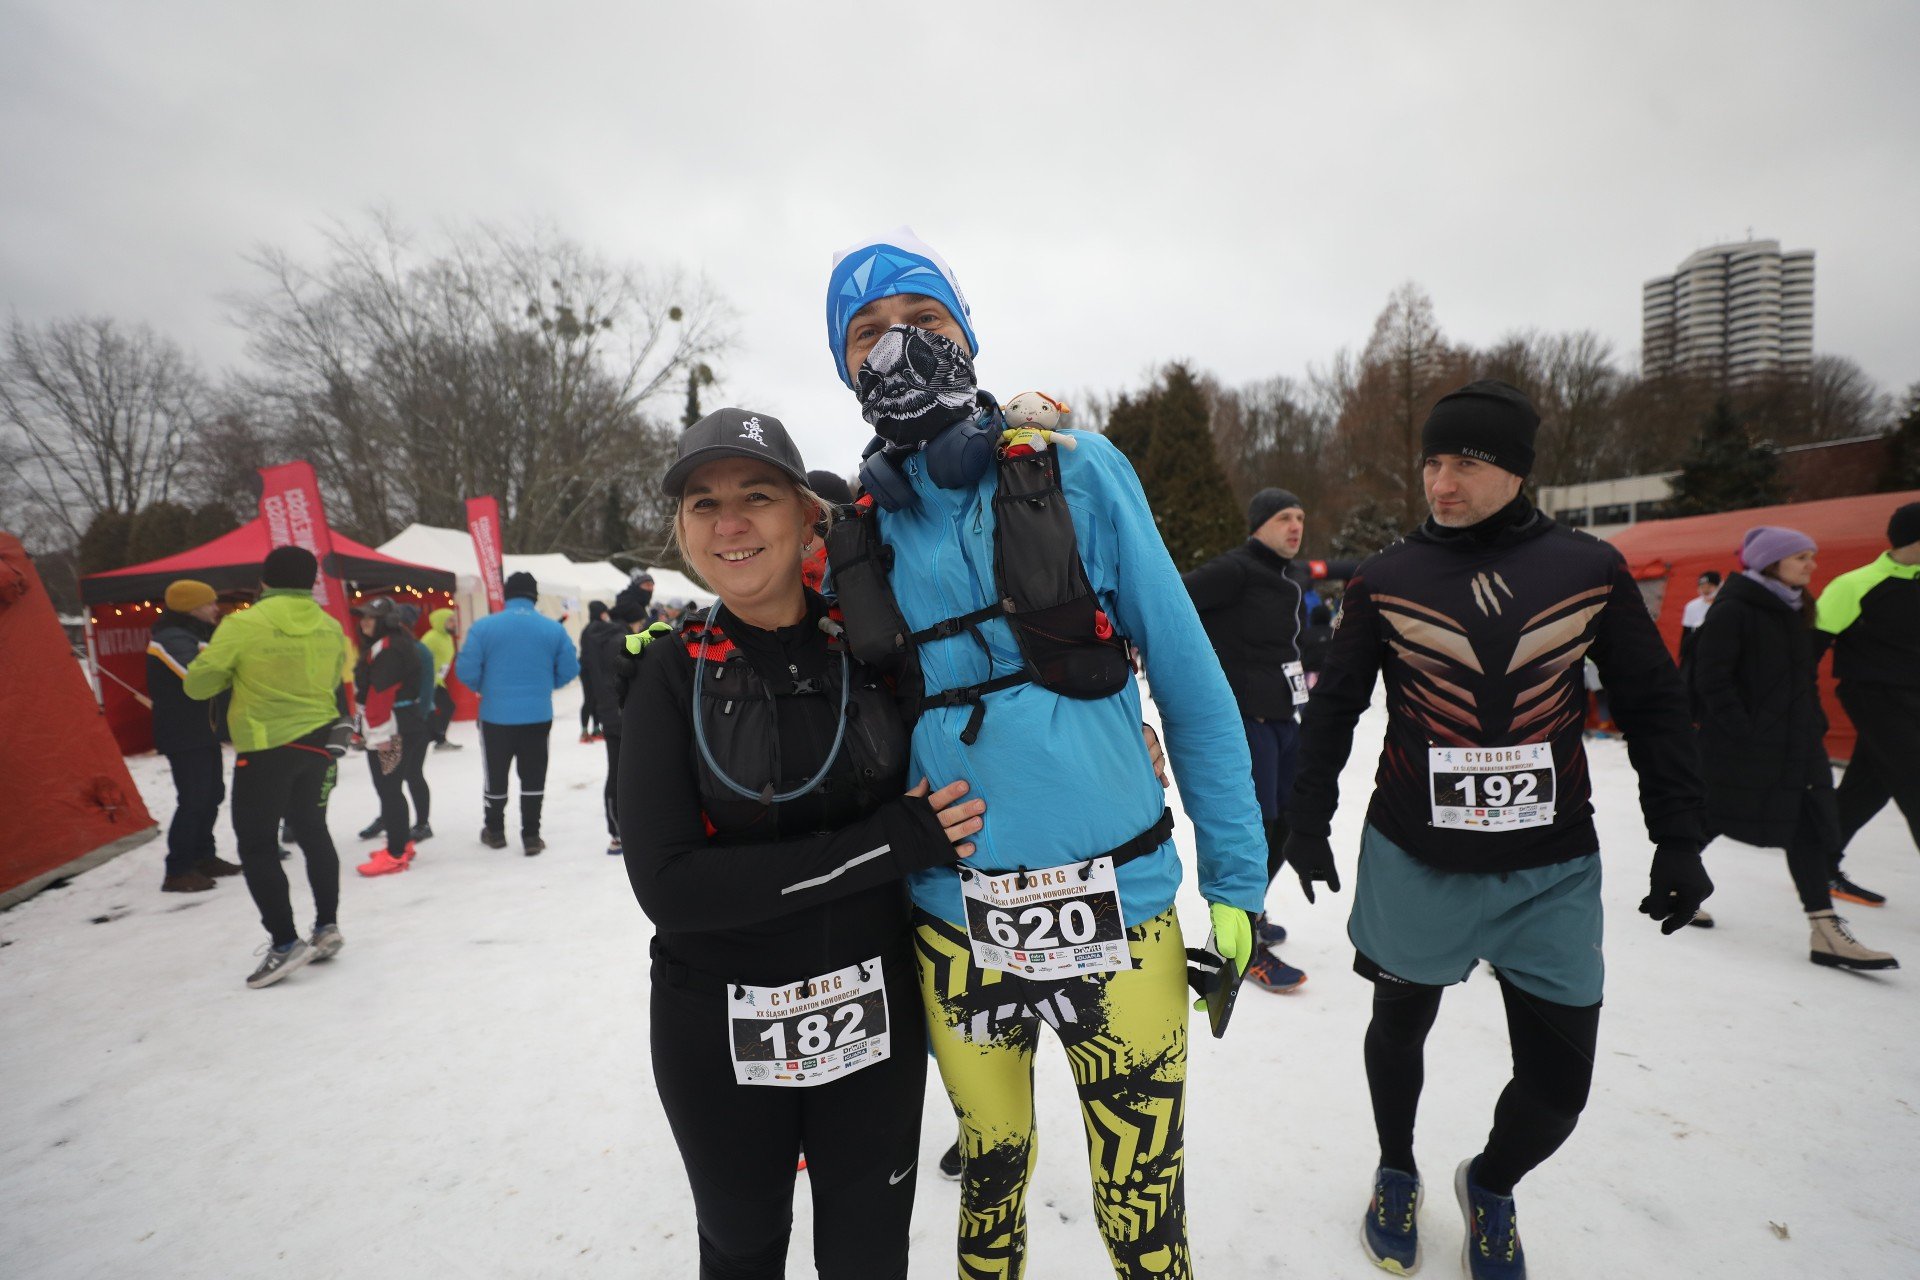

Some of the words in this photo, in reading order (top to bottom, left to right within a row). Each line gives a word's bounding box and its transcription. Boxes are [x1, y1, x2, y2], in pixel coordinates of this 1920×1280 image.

[1462, 447, 1497, 463] KALENJI
[1465, 750, 1521, 763] CYBORG
[1455, 772, 1538, 807] 192
[1010, 893, 1041, 906] MARATON
[1042, 885, 1088, 899] NOWOROCZNY
[986, 901, 1097, 950] 620
[756, 1010, 765, 1018] XX
[766, 1008, 788, 1019] ŚLĄSKI
[790, 1000, 819, 1014] MARATON
[820, 988, 861, 1007] NOWOROCZNY
[760, 1003, 867, 1059] 182
